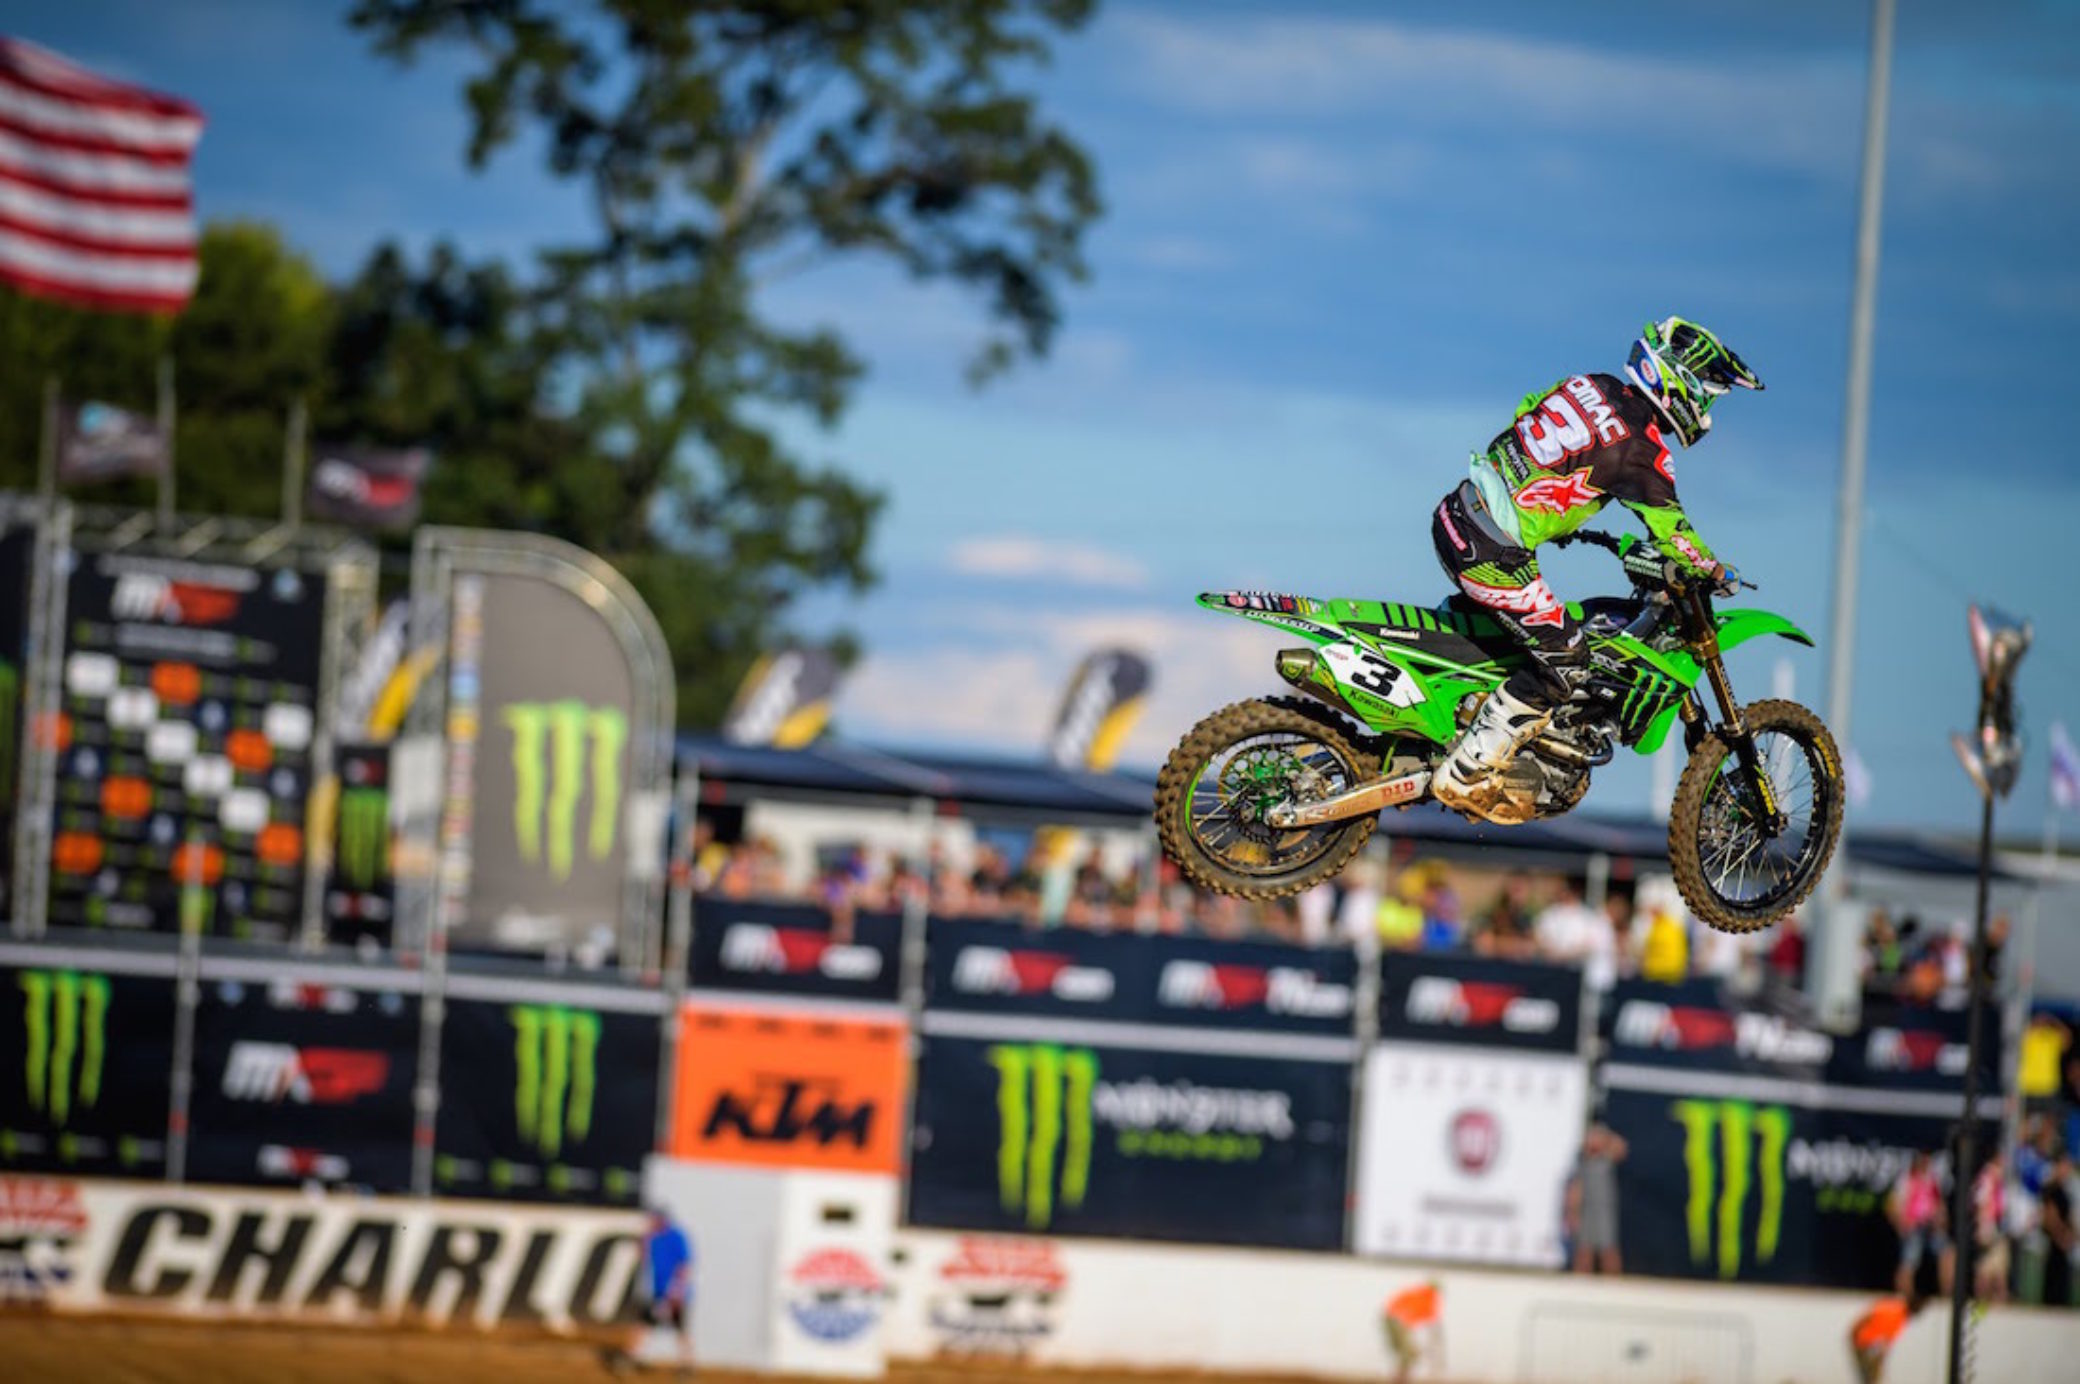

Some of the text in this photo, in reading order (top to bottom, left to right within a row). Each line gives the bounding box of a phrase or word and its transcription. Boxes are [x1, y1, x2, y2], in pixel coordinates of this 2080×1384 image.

[1517, 393, 1592, 466] 3
[1565, 374, 1627, 443] OMAC
[1351, 654, 1401, 696] 3
[702, 1081, 874, 1148] KTM
